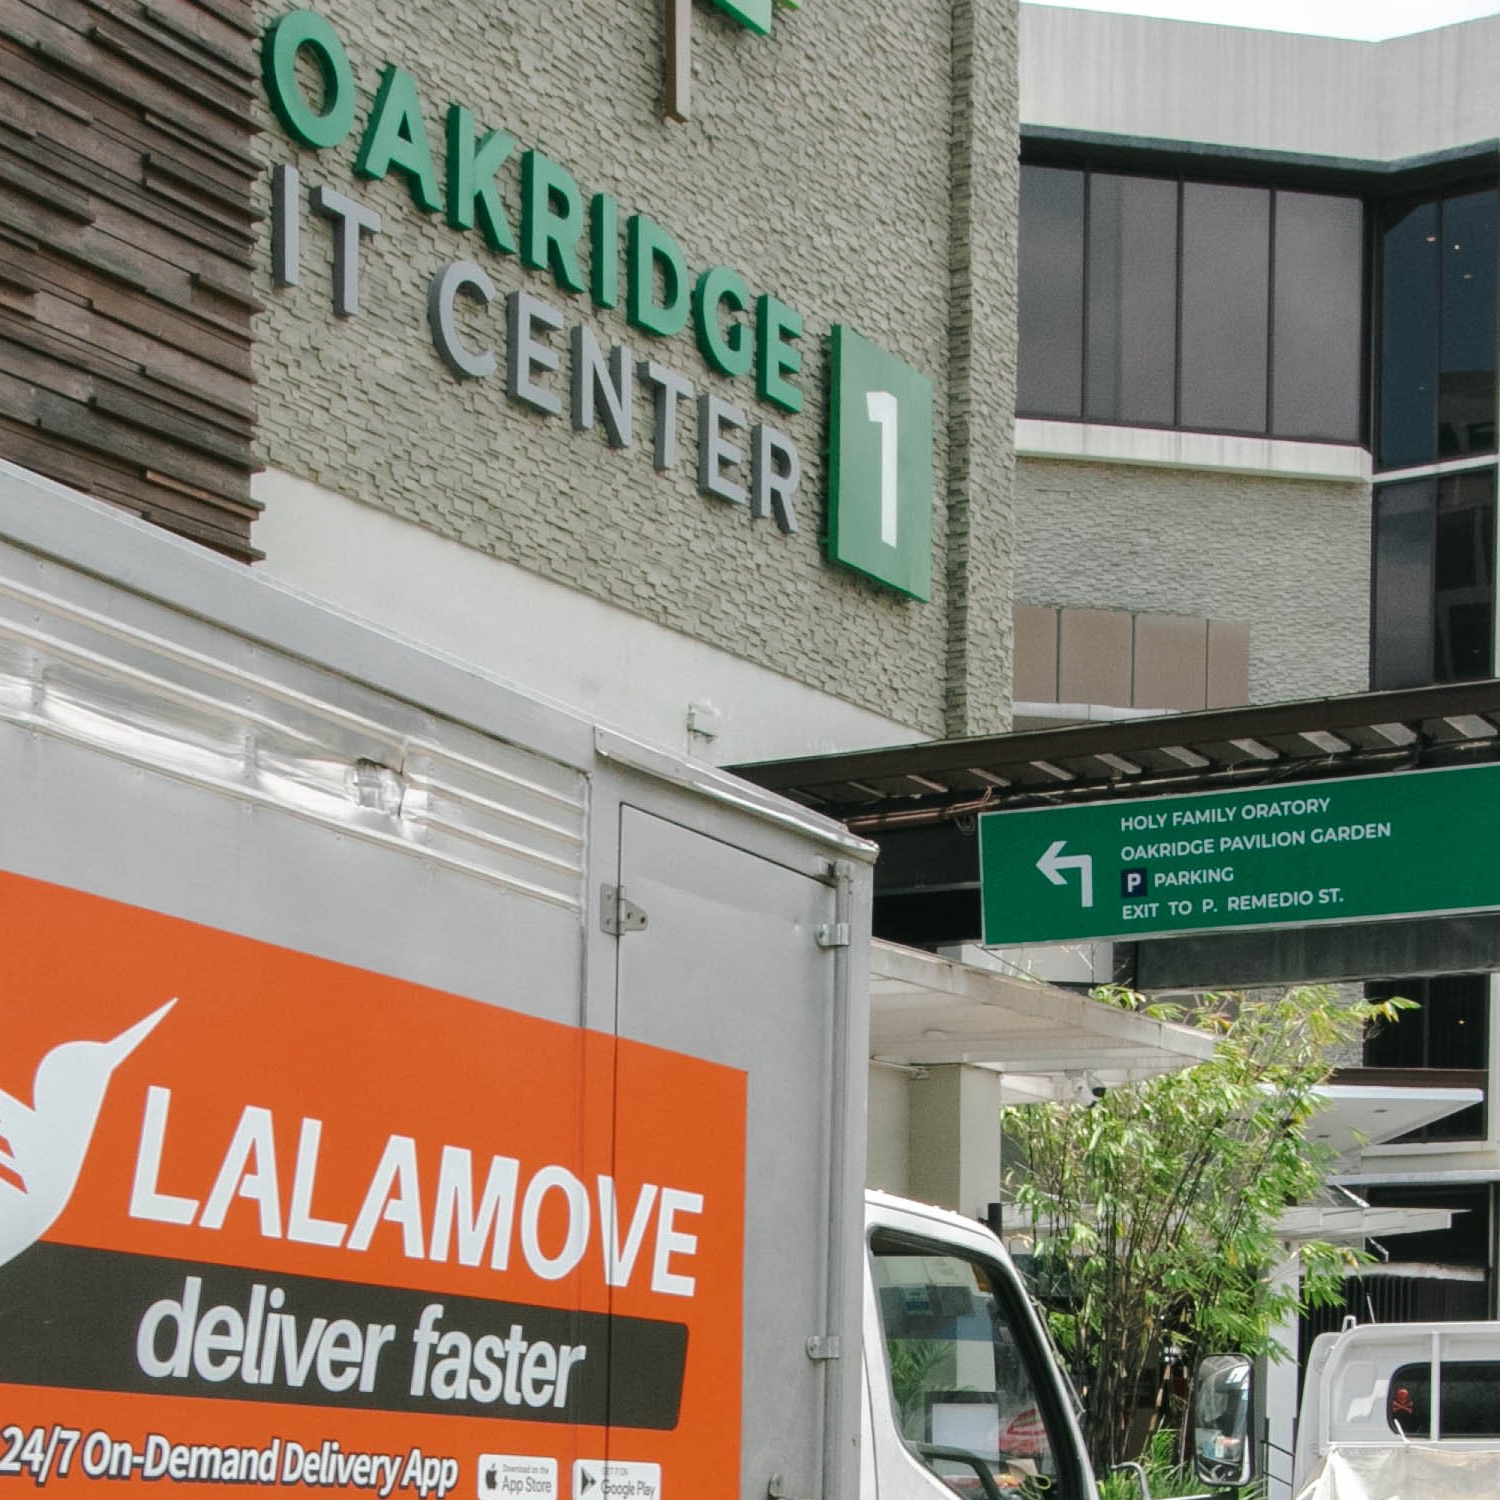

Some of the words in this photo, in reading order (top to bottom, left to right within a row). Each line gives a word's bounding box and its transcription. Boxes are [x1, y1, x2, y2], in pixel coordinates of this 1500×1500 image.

[262, 8, 802, 414] OAKRIDGE
[272, 164, 381, 317] IT
[427, 261, 800, 534] CENTER
[865, 391, 898, 549] 1
[1120, 812, 1168, 832] HOLY
[1172, 806, 1237, 827] FAMILY
[1240, 798, 1331, 822] ORATORY
[1120, 838, 1215, 861] OAKRIDGE
[1219, 829, 1306, 853] PAVILION
[1310, 821, 1392, 845] GARDEN
[1122, 902, 1160, 921] EXIT
[1168, 900, 1193, 916] TO
[1202, 898, 1218, 914] P.
[1227, 890, 1314, 912] REMEDIO
[1318, 887, 1345, 906] ST.
[1126, 873, 1142, 893] P
[1153, 867, 1234, 888] PARKING
[128, 1085, 704, 1297] LALAMOVE
[136, 1275, 394, 1394] deliver
[411, 1303, 586, 1410] faster
[81, 1429, 278, 1489] On-Demand
[280, 1439, 404, 1497] Delivery
[402, 1453, 460, 1499] App
[501, 1475, 525, 1495] App
[525, 1476, 552, 1493] Store
[601, 1480, 636, 1499] Google
[638, 1481, 657, 1500] Play
